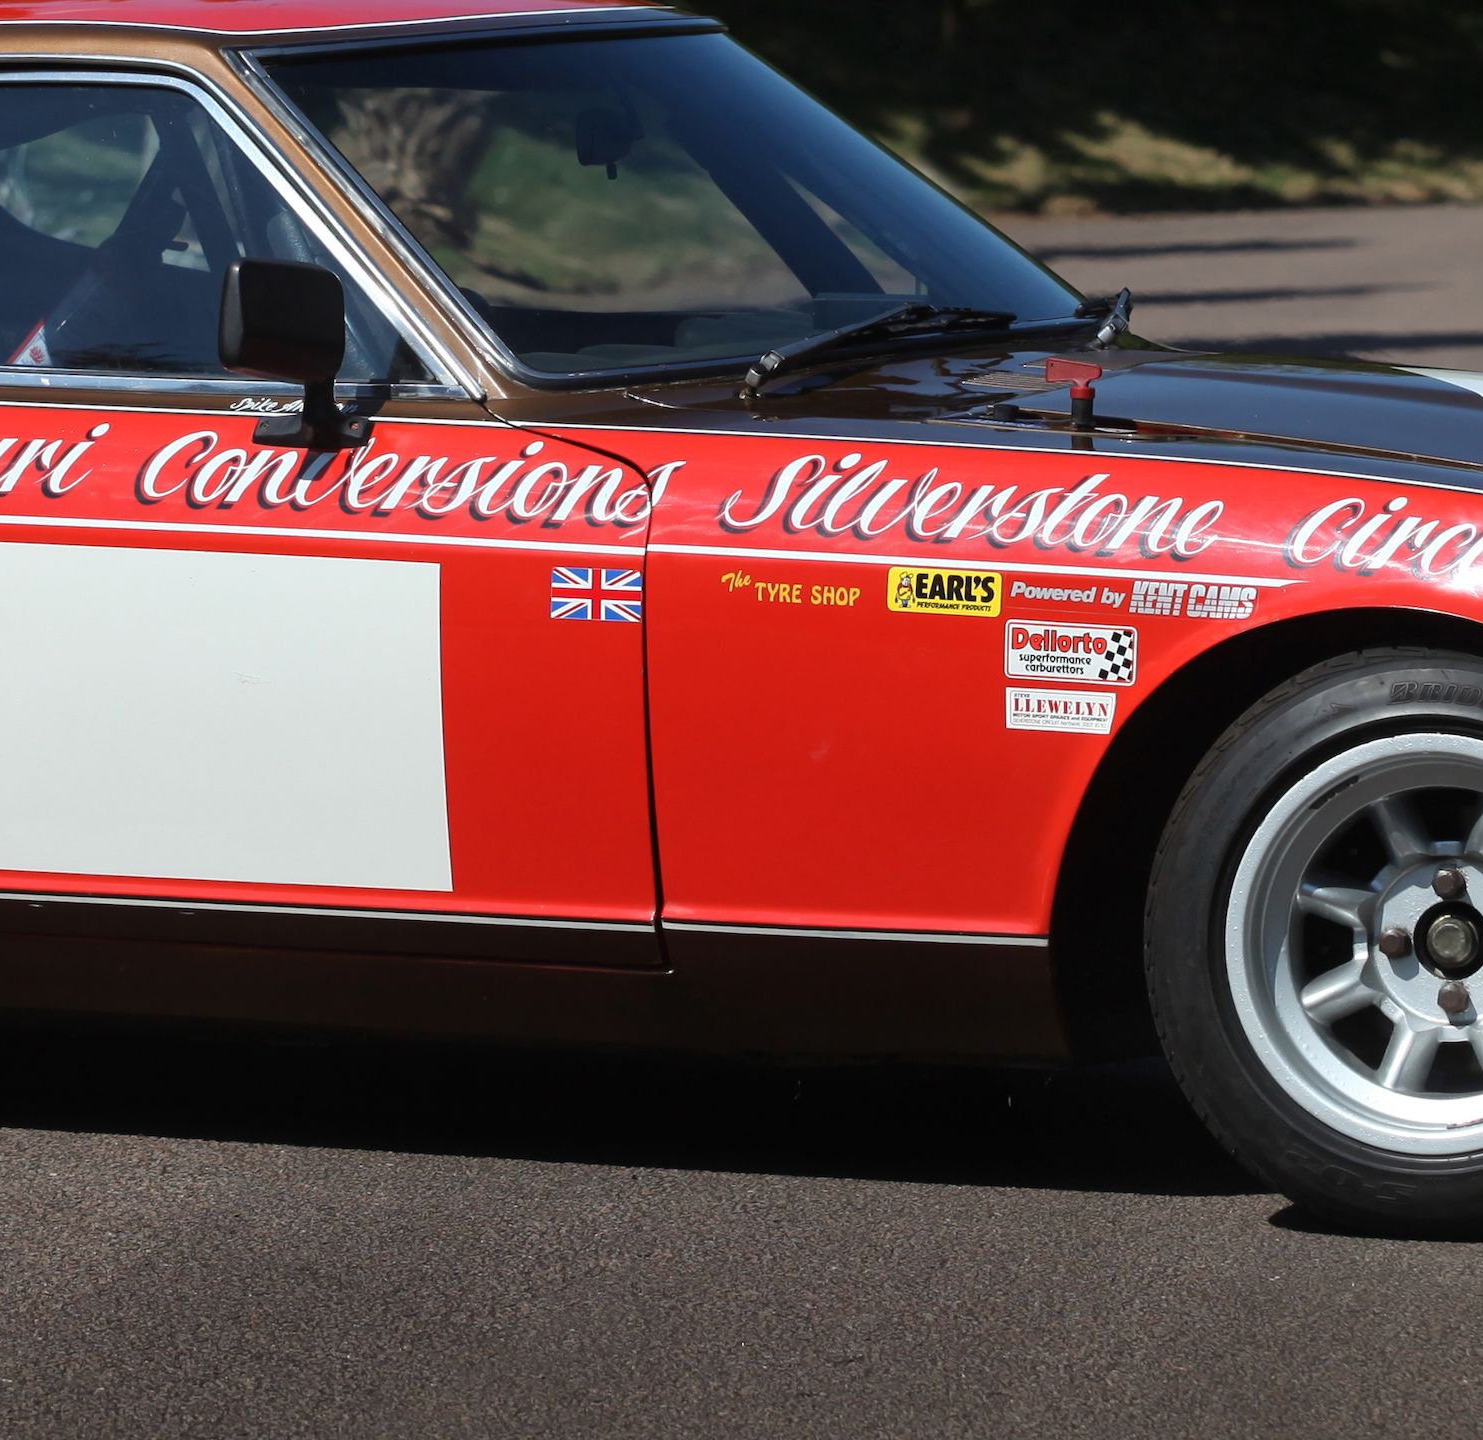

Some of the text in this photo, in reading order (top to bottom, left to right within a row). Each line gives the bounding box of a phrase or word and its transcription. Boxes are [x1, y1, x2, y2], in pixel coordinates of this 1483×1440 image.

[139, 429, 687, 523] Conversions
[715, 452, 1225, 557] Silverstone
[721, 570, 861, 607] The TYRE SHOP
[915, 572, 995, 603] EARL'S
[1010, 580, 1258, 620] Powered by KENT CAMS
[916, 601, 992, 612] PERFORMANCE PRODUCTS
[1011, 626, 1108, 655] Dellorto
[1019, 653, 1092, 666] superformance
[1025, 662, 1084, 675] carburettors
[1013, 698, 1109, 717] LLEWELYN
